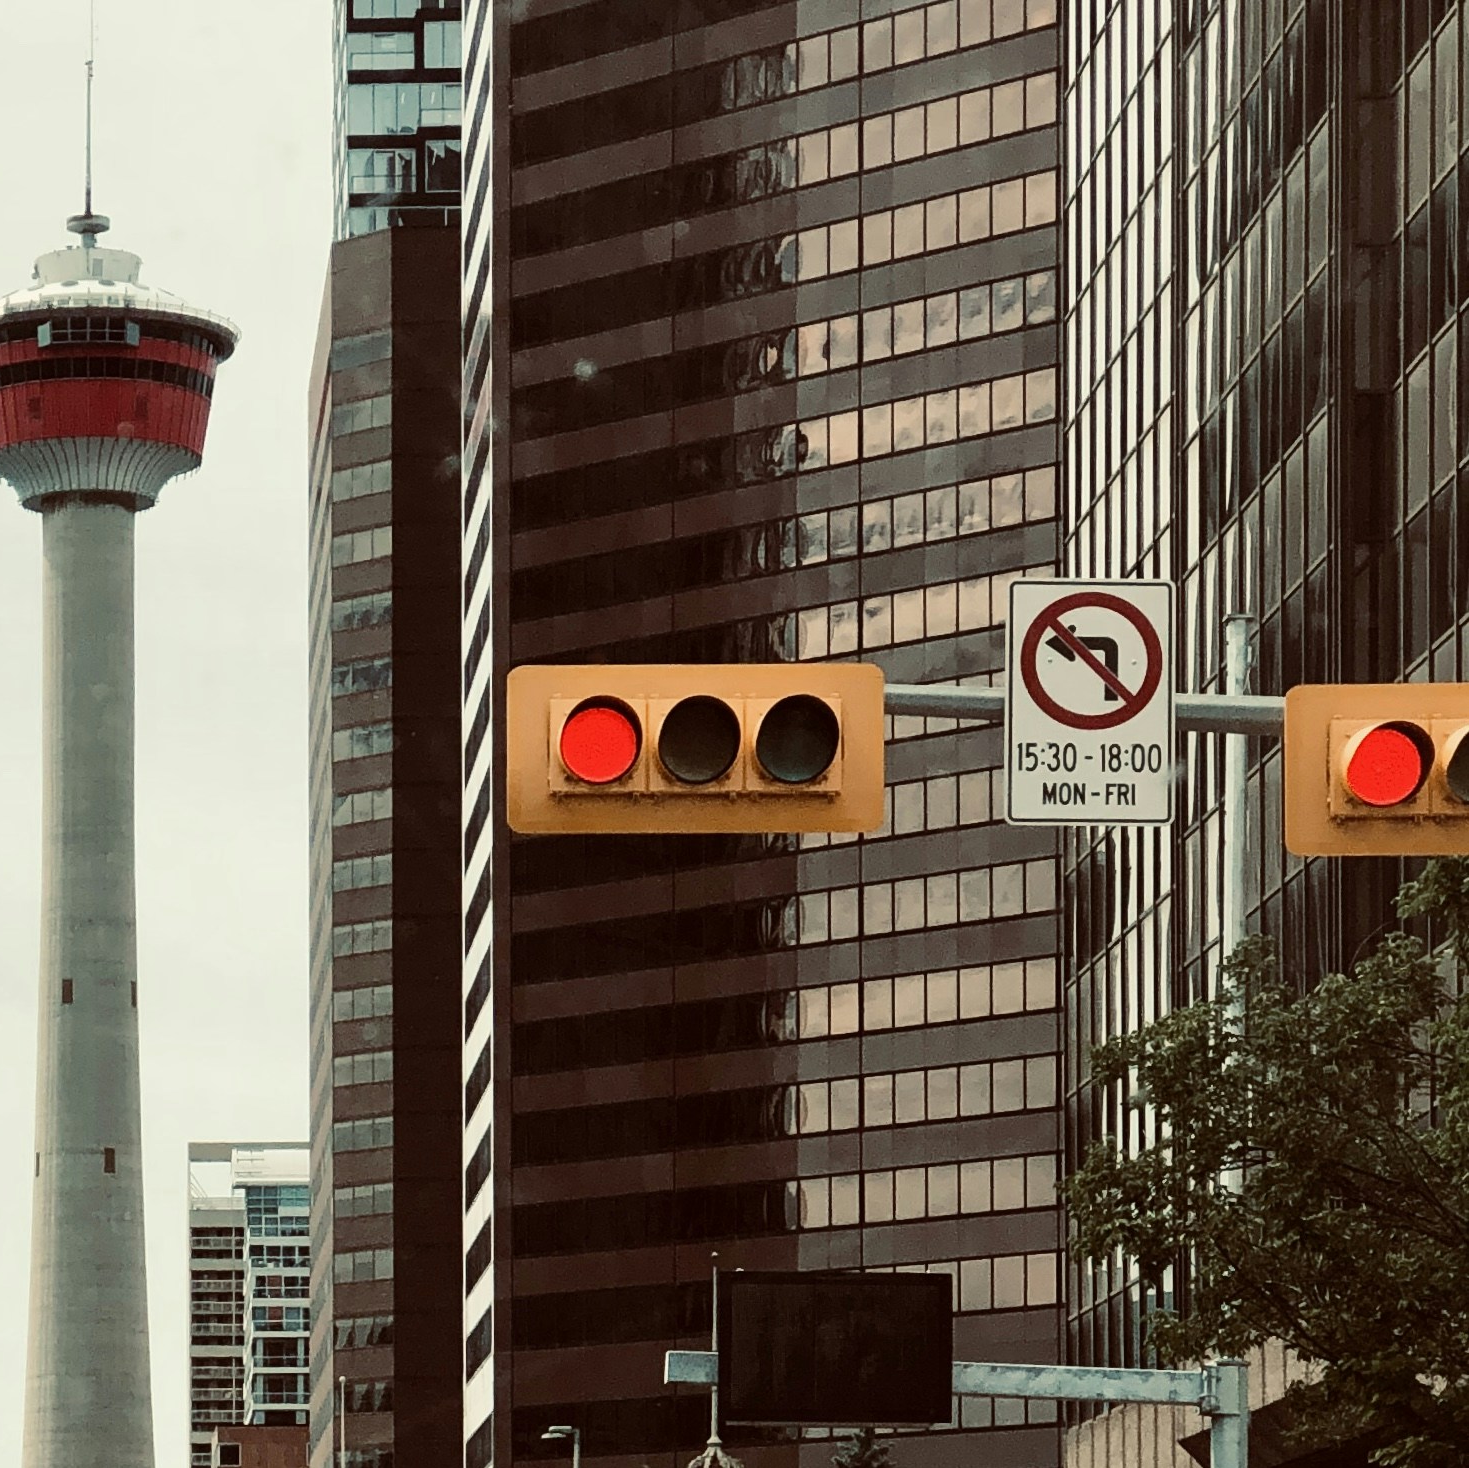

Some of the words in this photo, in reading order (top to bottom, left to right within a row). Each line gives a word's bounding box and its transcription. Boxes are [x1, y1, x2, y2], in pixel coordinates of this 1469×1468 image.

[1017, 742, 1077, 772] 15:30
[1100, 743, 1162, 773] 18:00
[1042, 782, 1086, 805] MON
[1105, 783, 1136, 806] FRI
